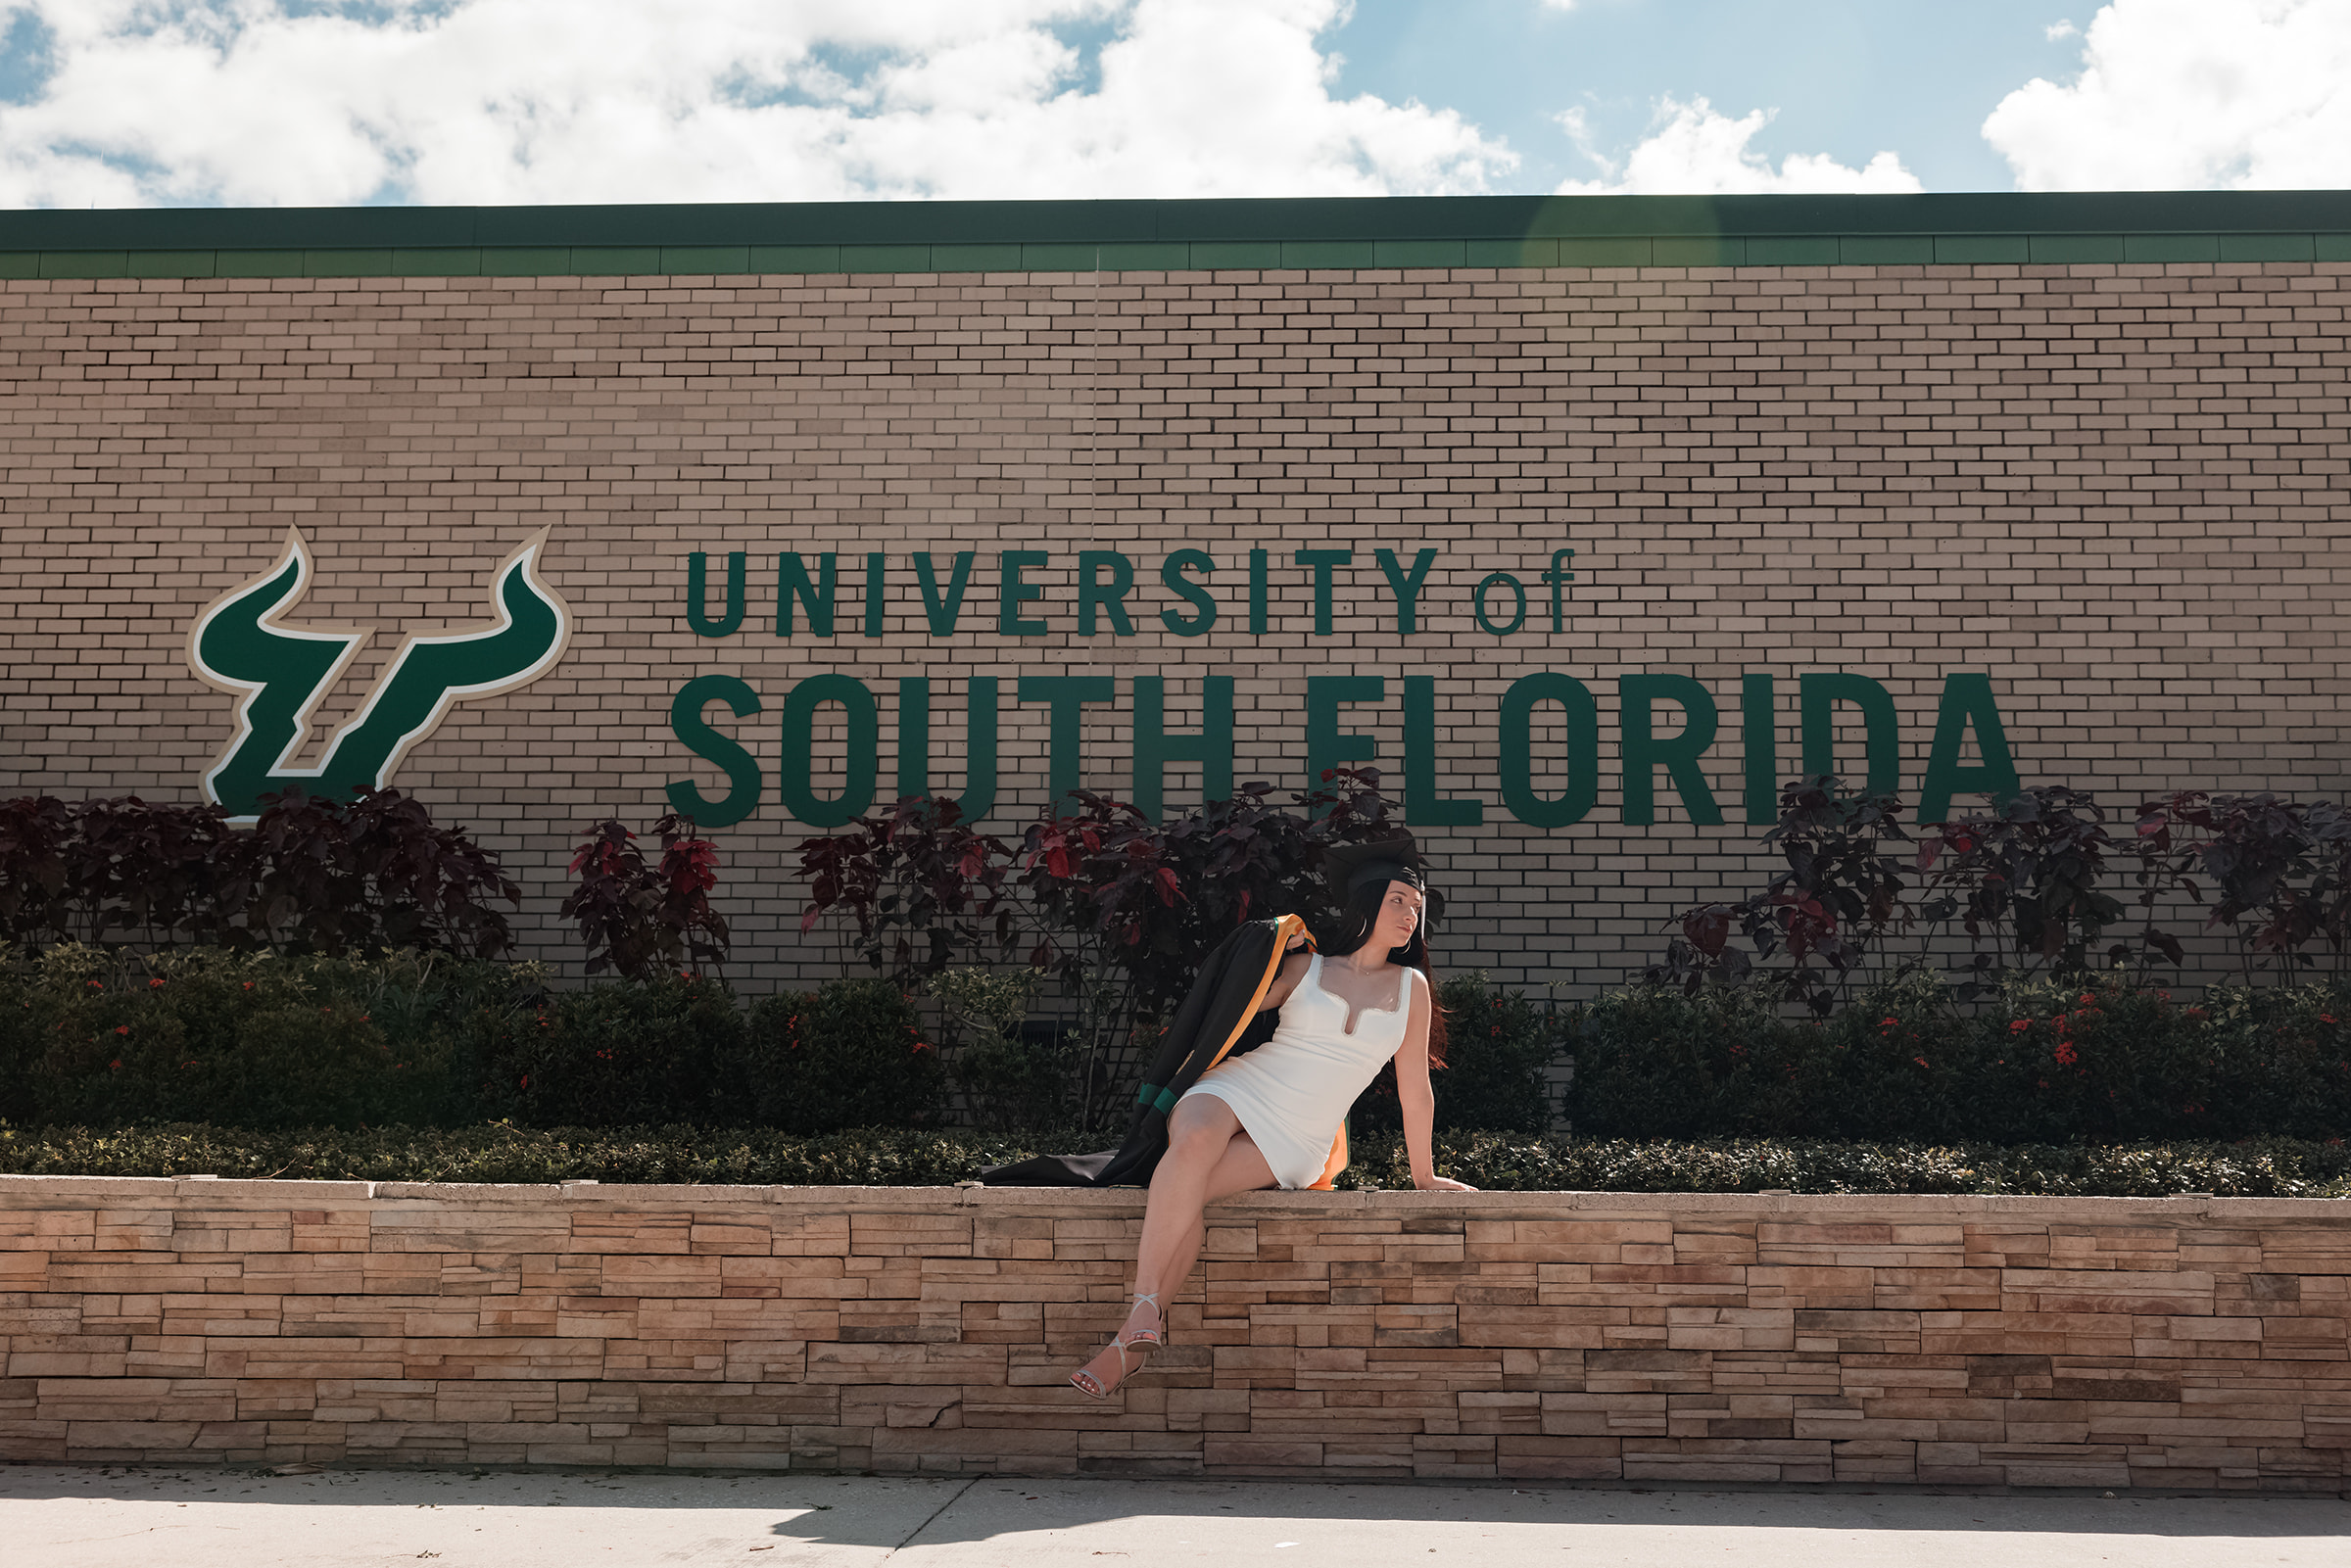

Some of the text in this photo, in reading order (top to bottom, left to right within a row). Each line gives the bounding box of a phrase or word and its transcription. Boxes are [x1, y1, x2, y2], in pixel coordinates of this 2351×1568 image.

[687, 548, 1575, 637] UNIVERSITY of
[665, 672, 2022, 828] SOUTH FLORIDA
